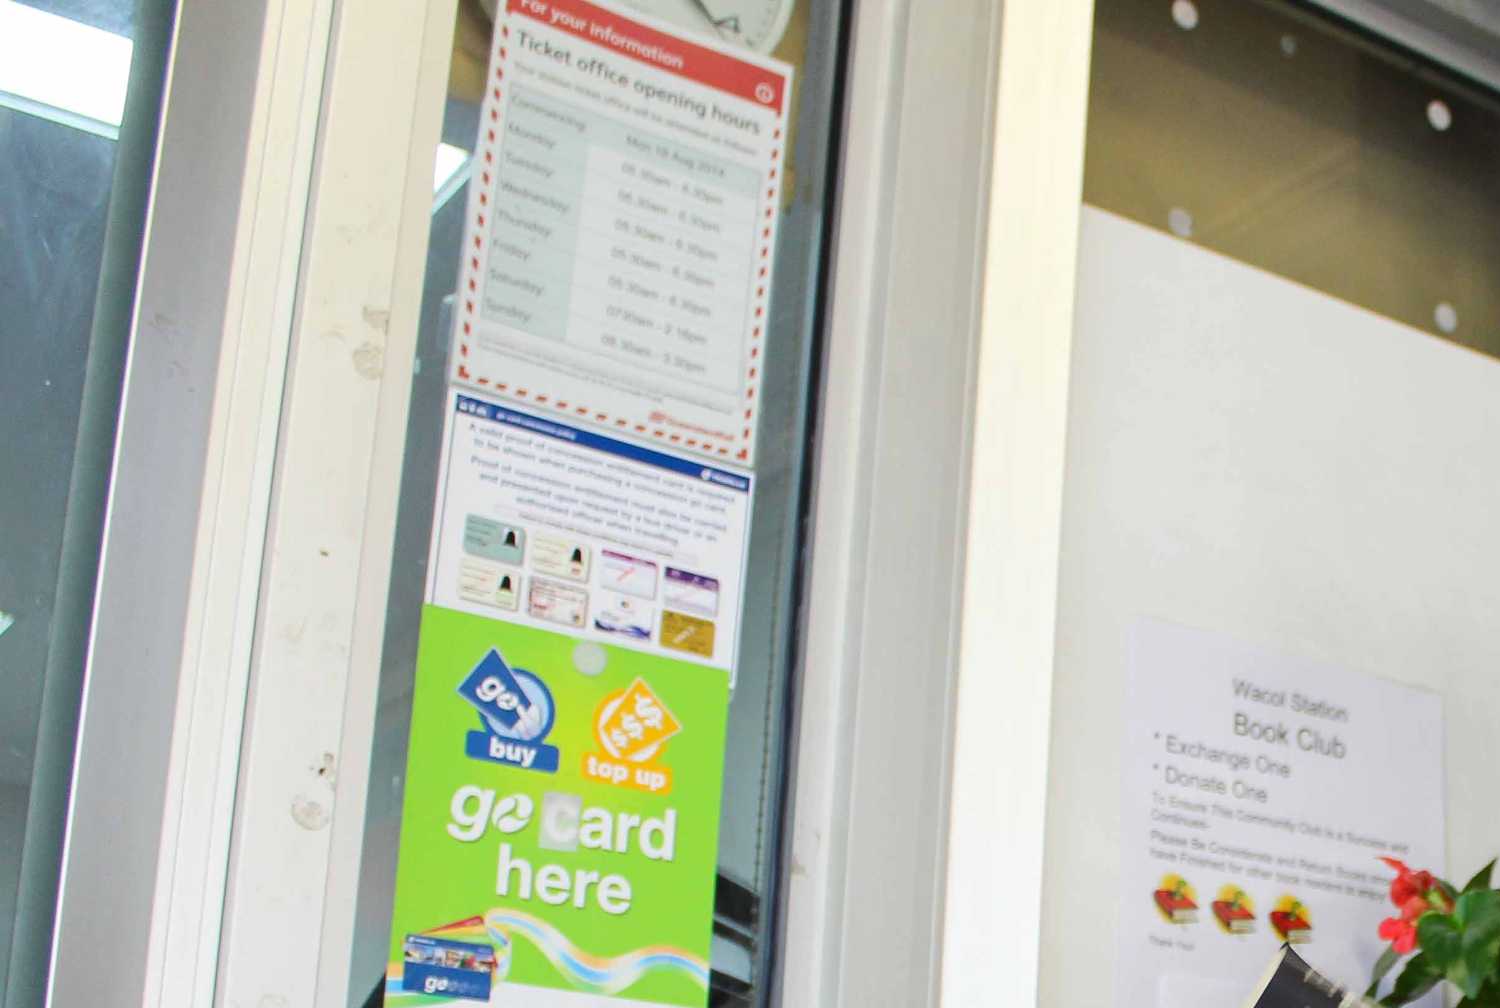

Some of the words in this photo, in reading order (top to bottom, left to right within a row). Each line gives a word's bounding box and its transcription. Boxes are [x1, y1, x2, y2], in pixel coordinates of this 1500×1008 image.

[550, 7, 587, 32] your
[590, 19, 684, 69] information
[516, 29, 571, 64] Ticket
[576, 53, 629, 86] office
[633, 76, 708, 118] opening
[712, 105, 760, 134] hours
[474, 677, 519, 711] go
[1232, 678, 1285, 708] Wacol
[1291, 693, 1348, 722] Station
[490, 737, 537, 767] buy
[1166, 735, 1250, 771] Exchange
[1256, 755, 1290, 778] One
[1233, 712, 1288, 744] Book
[1297, 728, 1346, 759] Club
[588, 756, 628, 784] top
[635, 767, 667, 791] up
[1166, 766, 1226, 794] Donate
[1232, 780, 1267, 803] One
[447, 785, 535, 842] go
[545, 797, 678, 861] card
[496, 843, 633, 915] here
